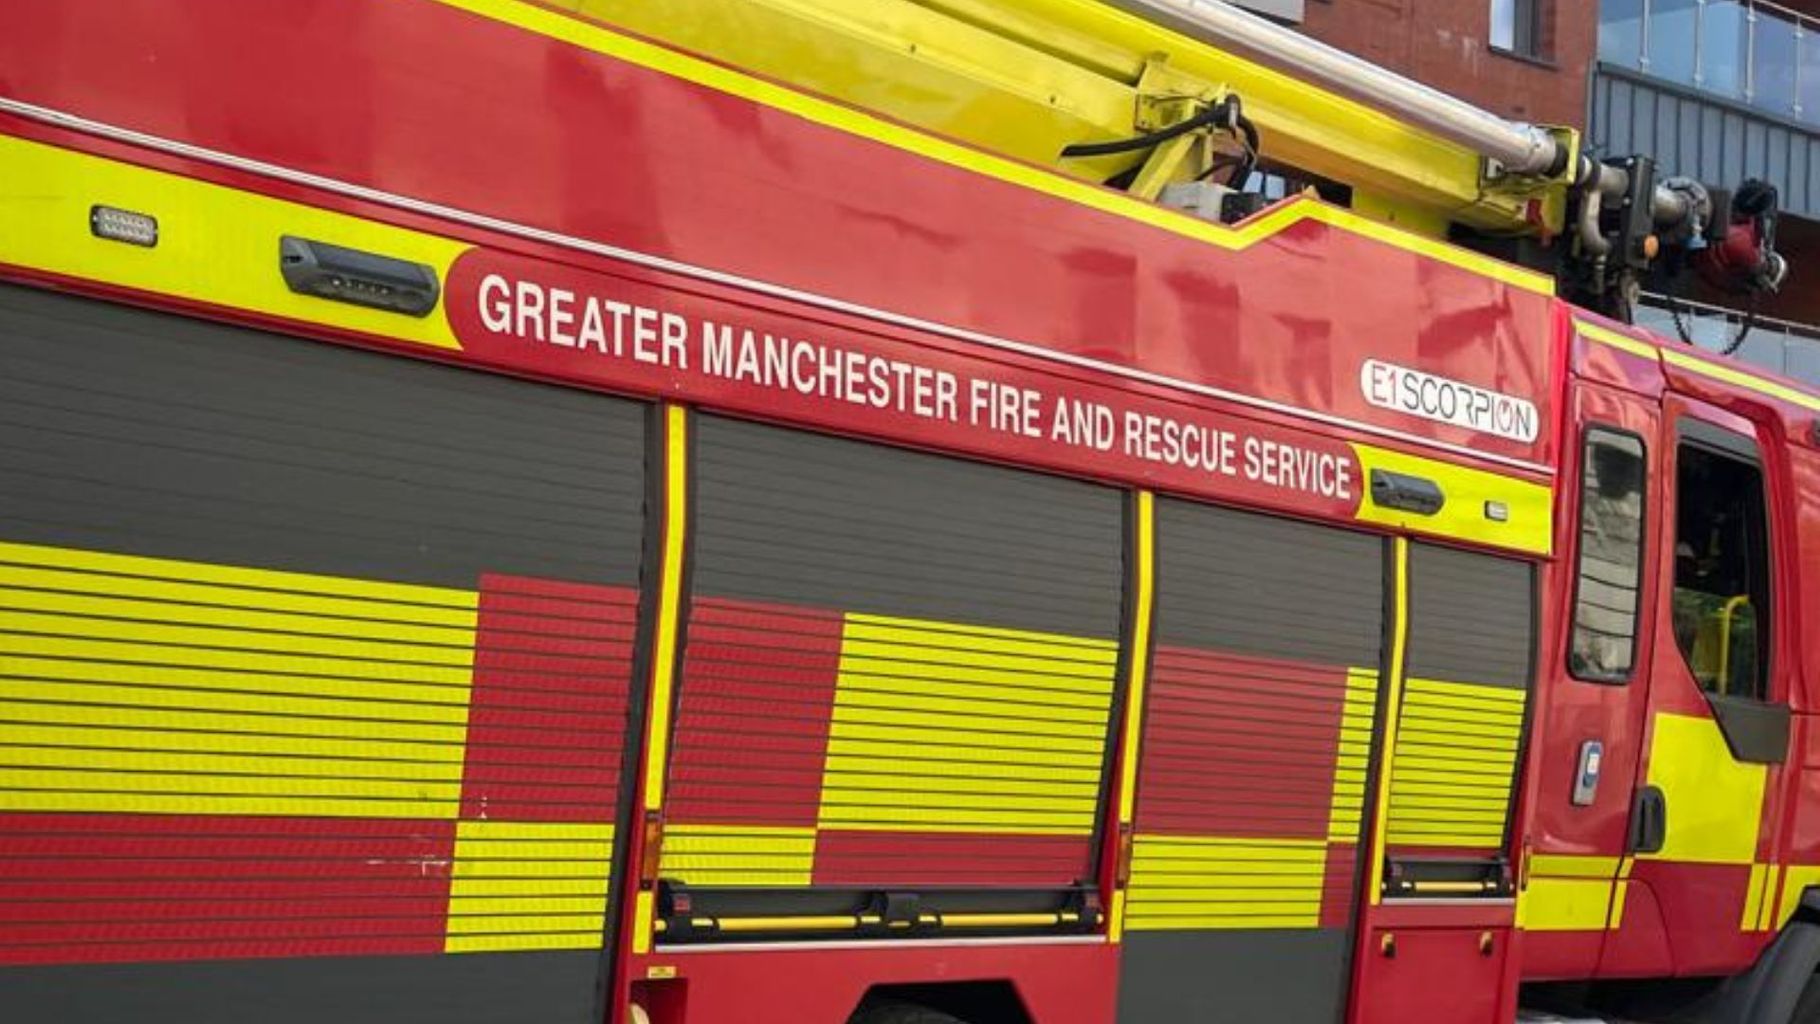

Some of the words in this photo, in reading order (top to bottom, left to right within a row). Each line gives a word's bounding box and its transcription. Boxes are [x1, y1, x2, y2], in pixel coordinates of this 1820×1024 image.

[478, 274, 688, 370] GREATER
[702, 322, 957, 421] MANCHESTER
[970, 379, 1041, 437] FIRE
[1052, 397, 1114, 450] AND
[1125, 411, 1236, 475] RESCUE
[1244, 437, 1350, 499] SERVICE
